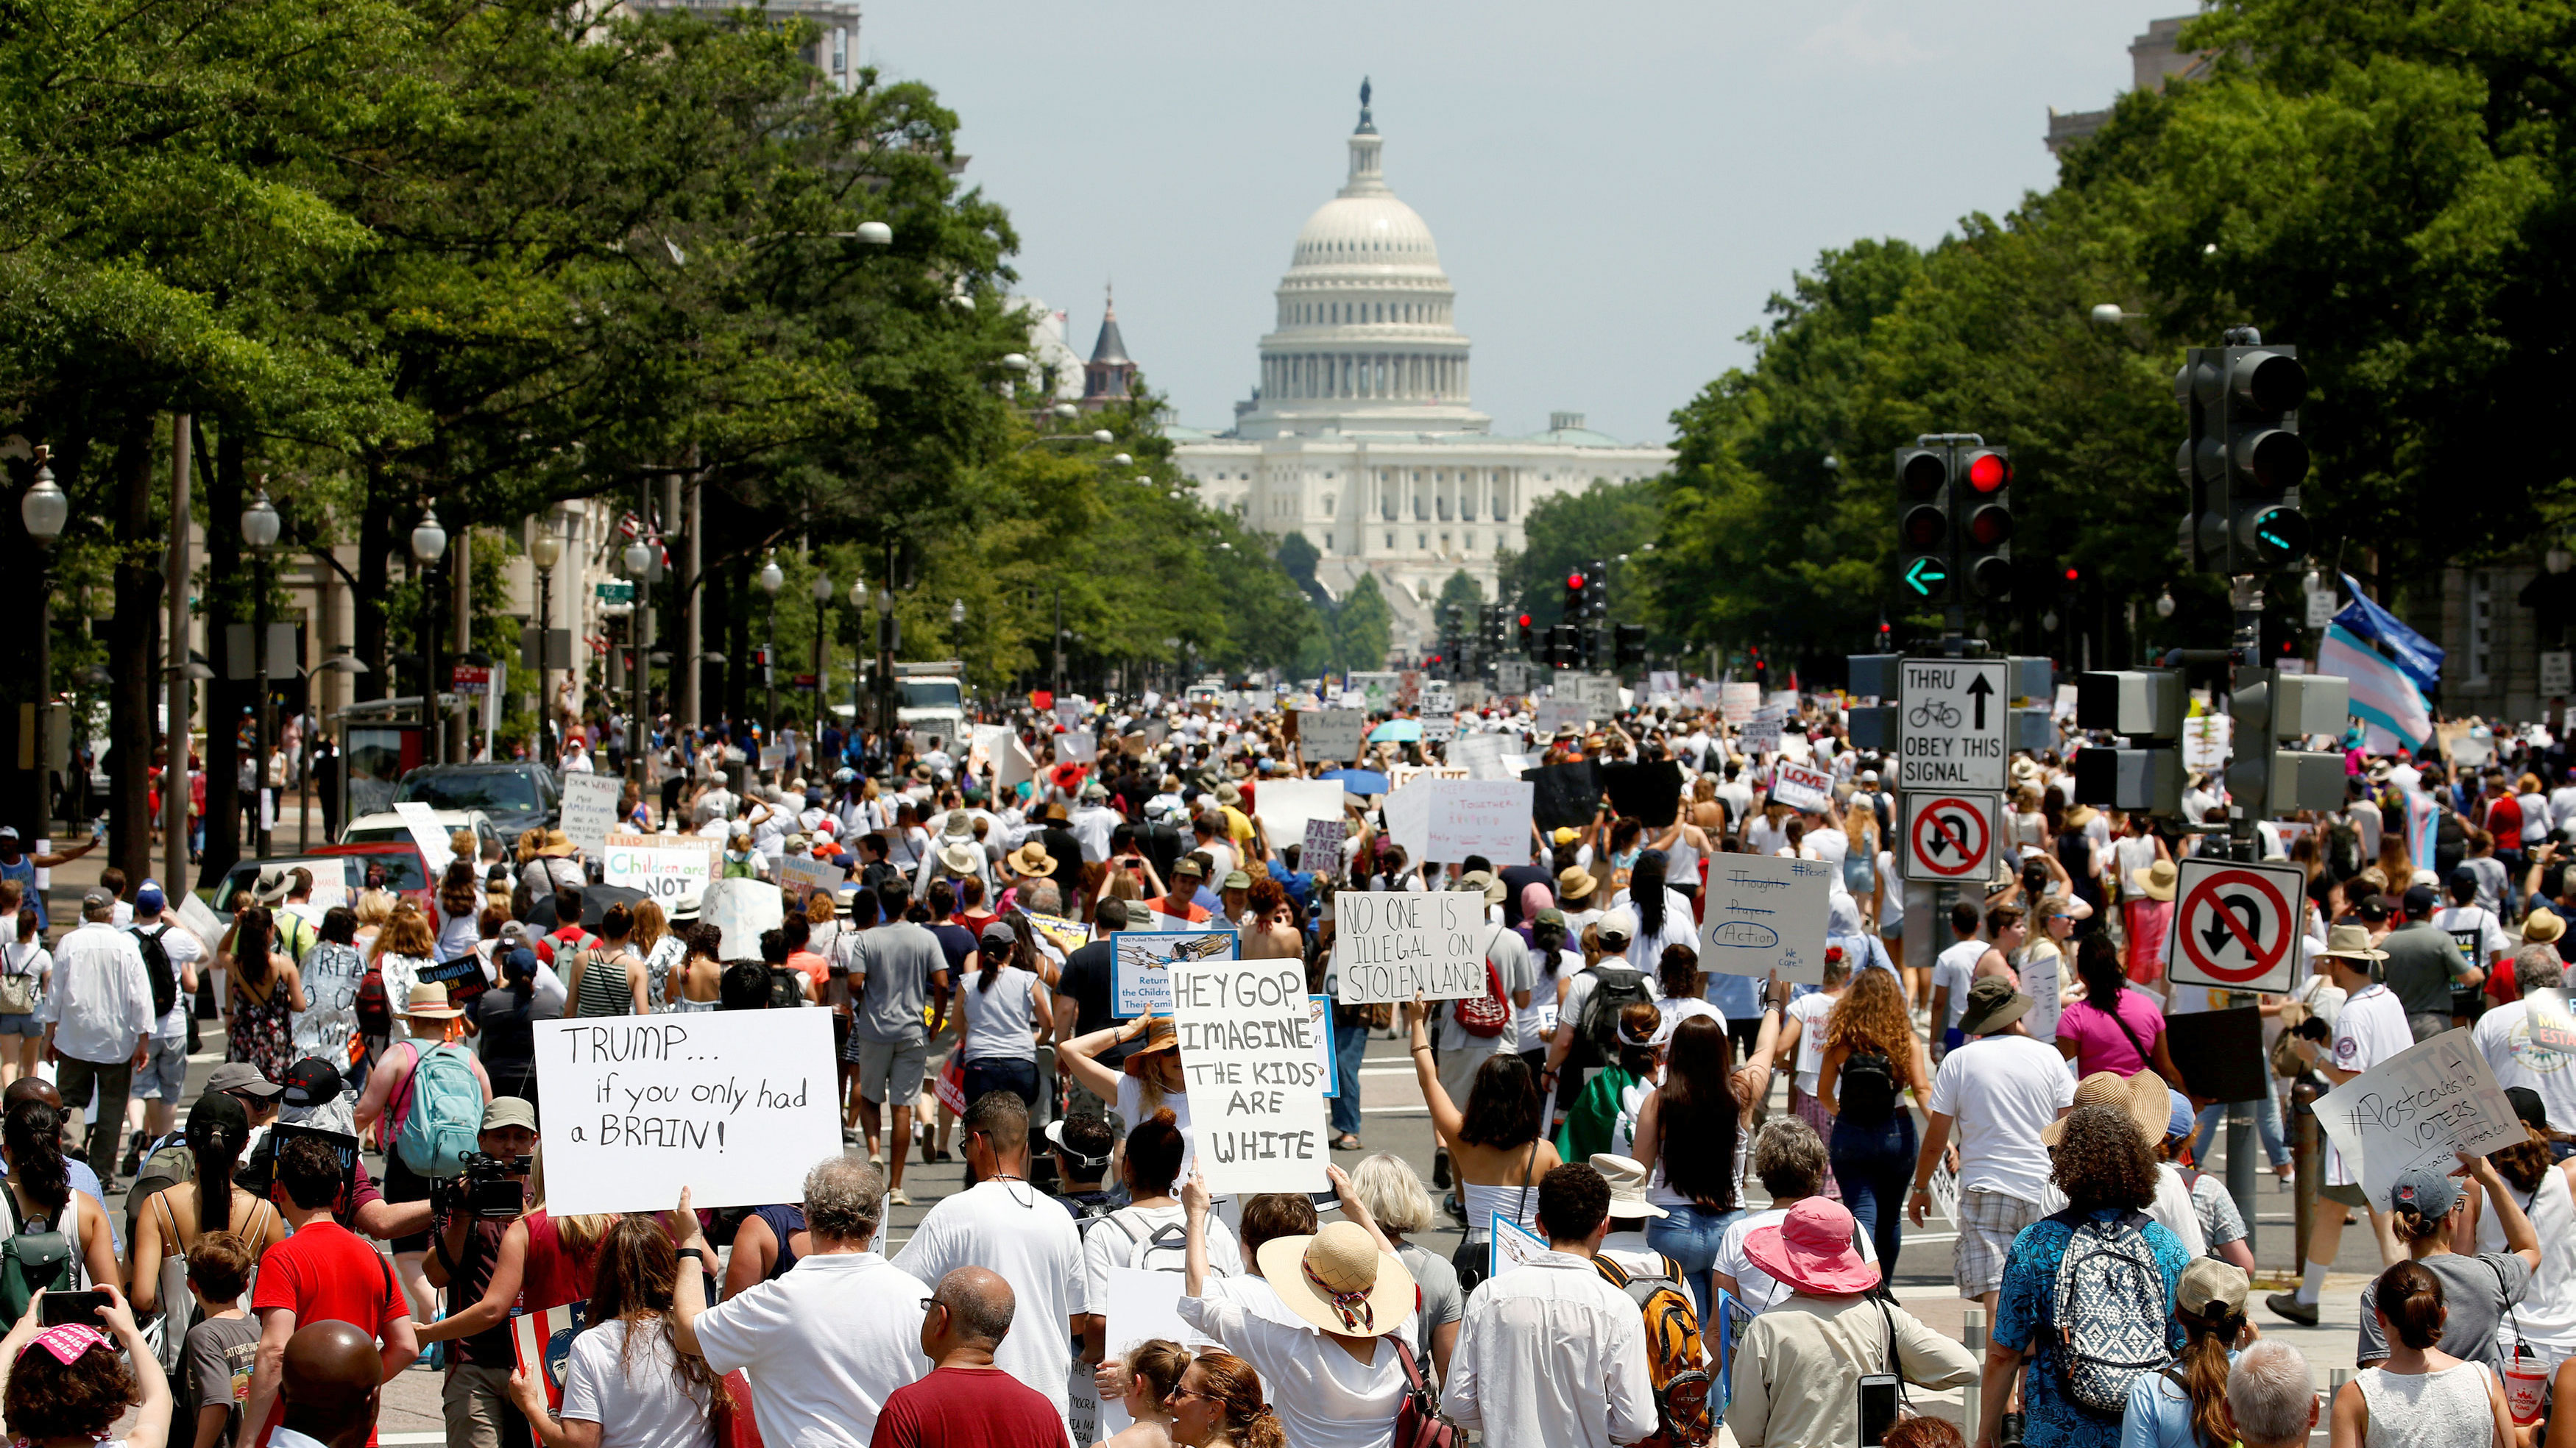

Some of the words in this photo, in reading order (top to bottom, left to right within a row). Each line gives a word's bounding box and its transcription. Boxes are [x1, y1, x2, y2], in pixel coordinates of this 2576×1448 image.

[1908, 669, 1956, 689] THRU
[1906, 737, 1953, 756] OBEY
[1961, 738, 2000, 758] THIS
[1784, 767, 1828, 789] LOVE
[1905, 762, 1969, 782] SIGNAL
[1306, 819, 1347, 840] FREE
[1306, 839, 1338, 852] THE
[610, 853, 679, 876] Children
[683, 864, 707, 876] are
[1791, 862, 1828, 877] #Resist
[645, 876, 691, 898] NOT
[1727, 870, 1787, 893] Thoughts
[1343, 896, 1373, 934] NO
[1387, 898, 1422, 931] ONE
[1440, 898, 1456, 930] IS
[1725, 924, 1774, 943] Action
[1353, 934, 1432, 963] ILLEGAL
[1448, 933, 1473, 957] ON
[1786, 948, 1797, 958] We
[434, 962, 475, 980] FAMILIAS
[1139, 976, 1169, 984] Return
[1349, 964, 1425, 1001] STOLEN
[1430, 962, 1481, 993] LAND
[1139, 988, 1170, 996] Childre
[1175, 972, 1228, 1008] HEY
[1235, 971, 1301, 1011] GOP,
[1150, 1000, 1172, 1008] Famil
[560, 1024, 719, 1064] TRUMP...
[1181, 1018, 1314, 1051] IMAGINE
[1186, 1061, 1242, 1085] THE
[1253, 1062, 1317, 1087] KIDS
[597, 1072, 619, 1104] if
[625, 1085, 679, 1113] you
[691, 1076, 749, 1115] only
[757, 1077, 807, 1109] had
[1226, 1090, 1284, 1115] ARE
[571, 1126, 588, 1143] a
[601, 1114, 725, 1154] BRAIN!
[2404, 1100, 2478, 1150] VOTERS
[1212, 1130, 1314, 1163] WHITE
[43, 1335, 78, 1359] resist
[52, 1330, 88, 1351] resist
[2509, 1396, 2538, 1405] SMOOTHIE
